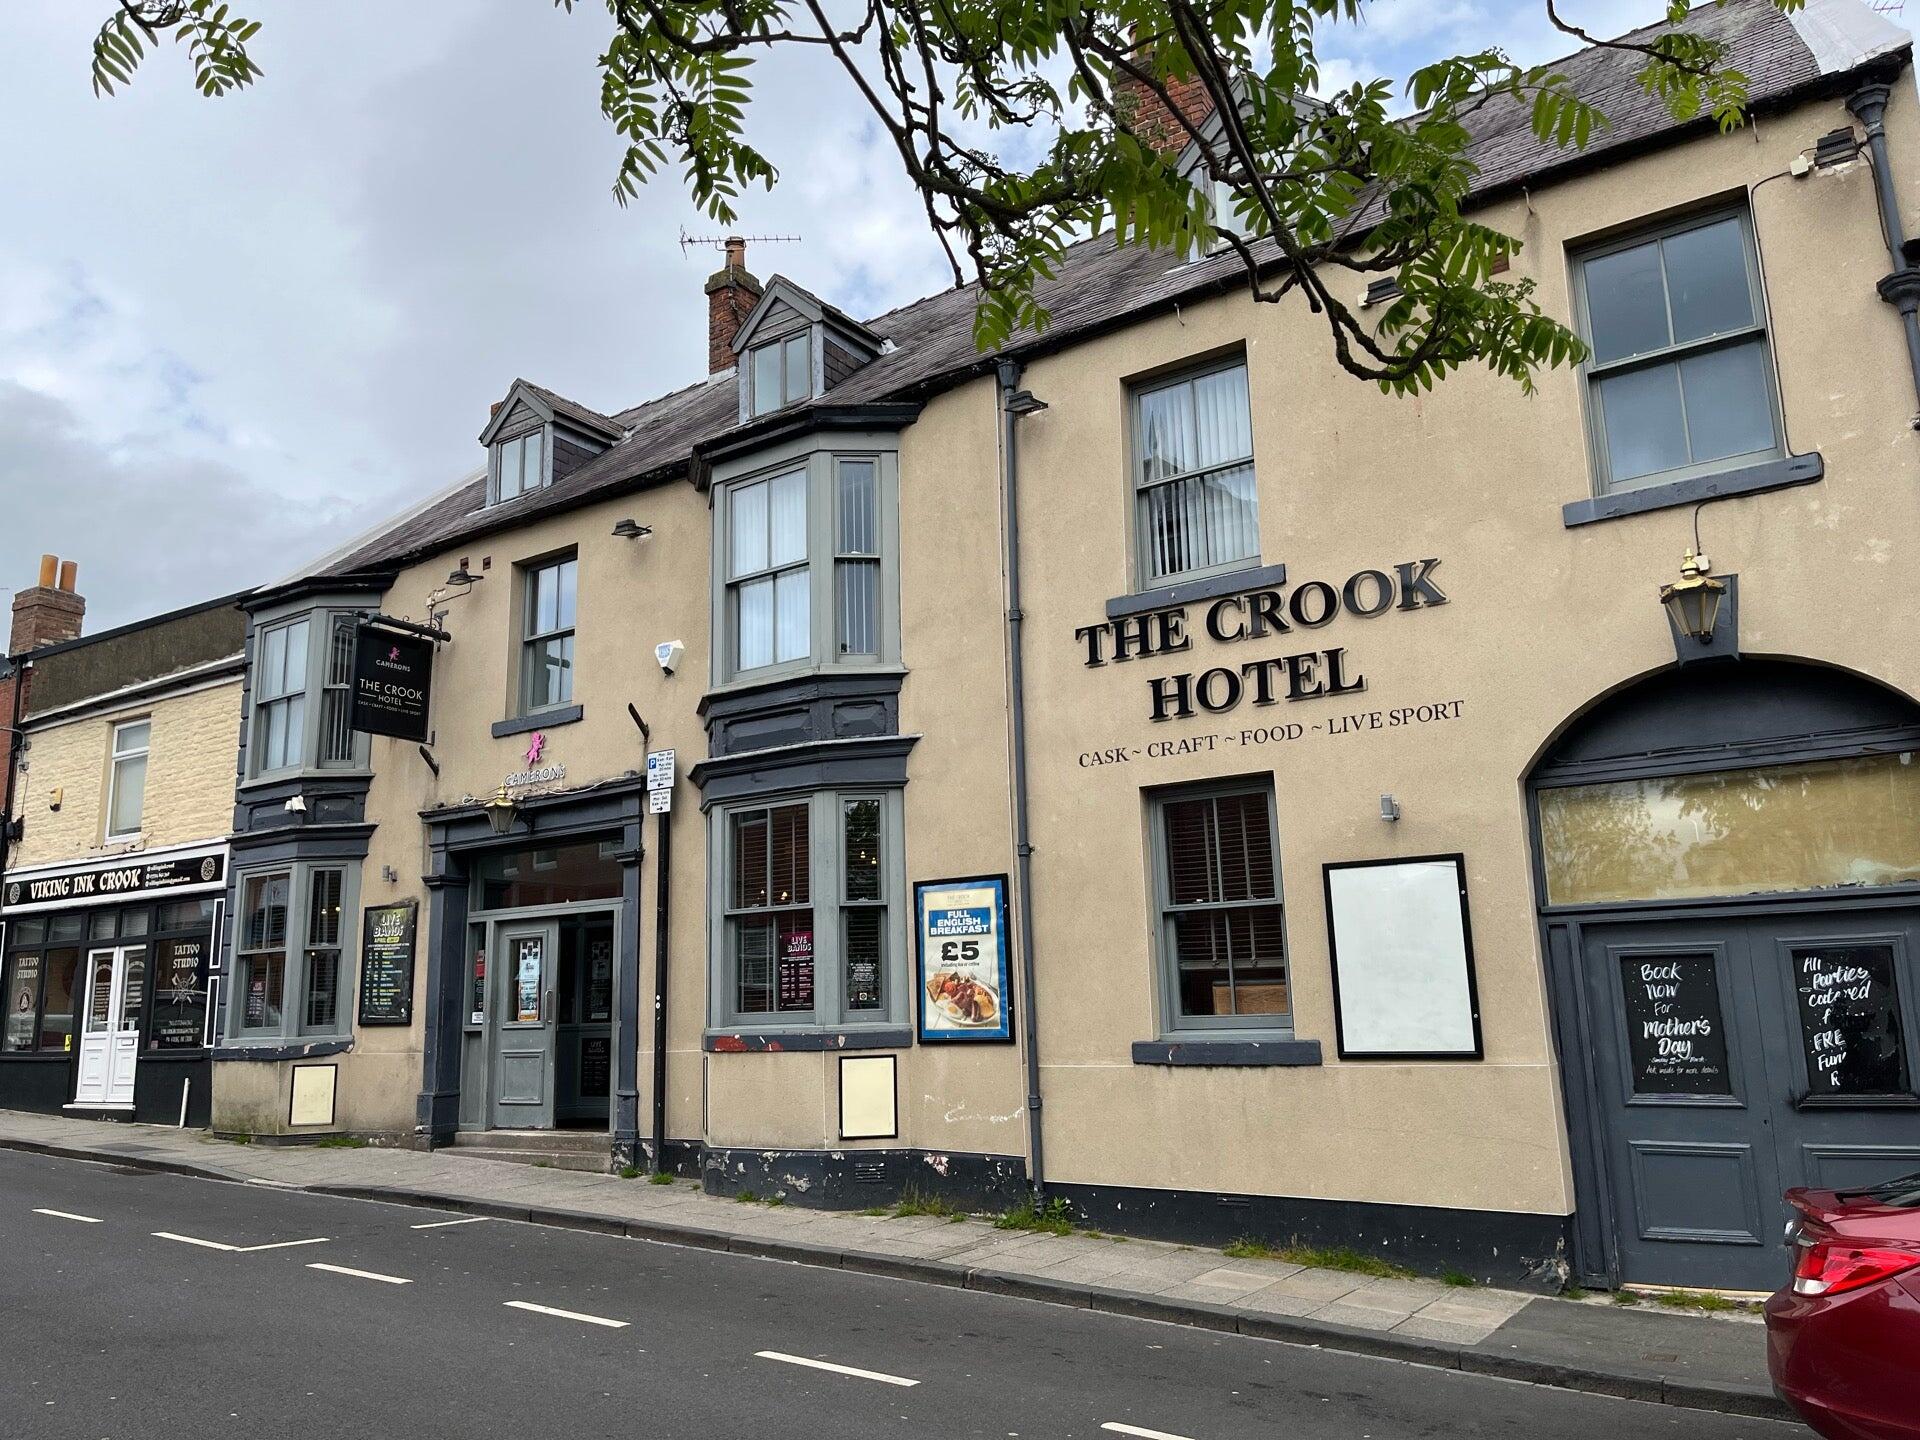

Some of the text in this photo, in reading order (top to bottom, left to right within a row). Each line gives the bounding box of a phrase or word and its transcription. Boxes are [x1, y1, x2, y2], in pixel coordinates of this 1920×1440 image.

[1075, 558, 1447, 666] THE CROOK
[376, 659, 410, 672] CAMERONS
[360, 678, 422, 700] THE CROOK
[1147, 647, 1364, 720] HOTEL
[378, 695, 402, 706] HOTEL
[1078, 747, 1130, 768] CASK
[1148, 734, 1218, 758] CRAFT
[1240, 723, 1303, 746] FOOD
[1328, 712, 1383, 734] LIVE
[1389, 700, 1464, 727] SPORT
[650, 759, 656, 769] P
[504, 764, 565, 787] CAMERONS
[30, 878, 70, 899] VIKING
[73, 874, 96, 894] INK
[100, 868, 141, 891] CROOK
[382, 914, 401, 926] LIVE
[947, 910, 970, 919] FULL
[938, 917, 981, 926] ENGLISH
[374, 925, 404, 938] BANDS
[930, 924, 988, 934] BREAKFAST
[791, 936, 807, 944] LIVE
[174, 944, 200, 956] TATTOO
[942, 940, 980, 961] £5
[18, 957, 38, 967] TATTOO
[172, 957, 198, 969] STUDIO
[17, 969, 38, 980] STUDIO
[1654, 1001, 1674, 1016] For
[1658, 1038, 1693, 1059] Day
